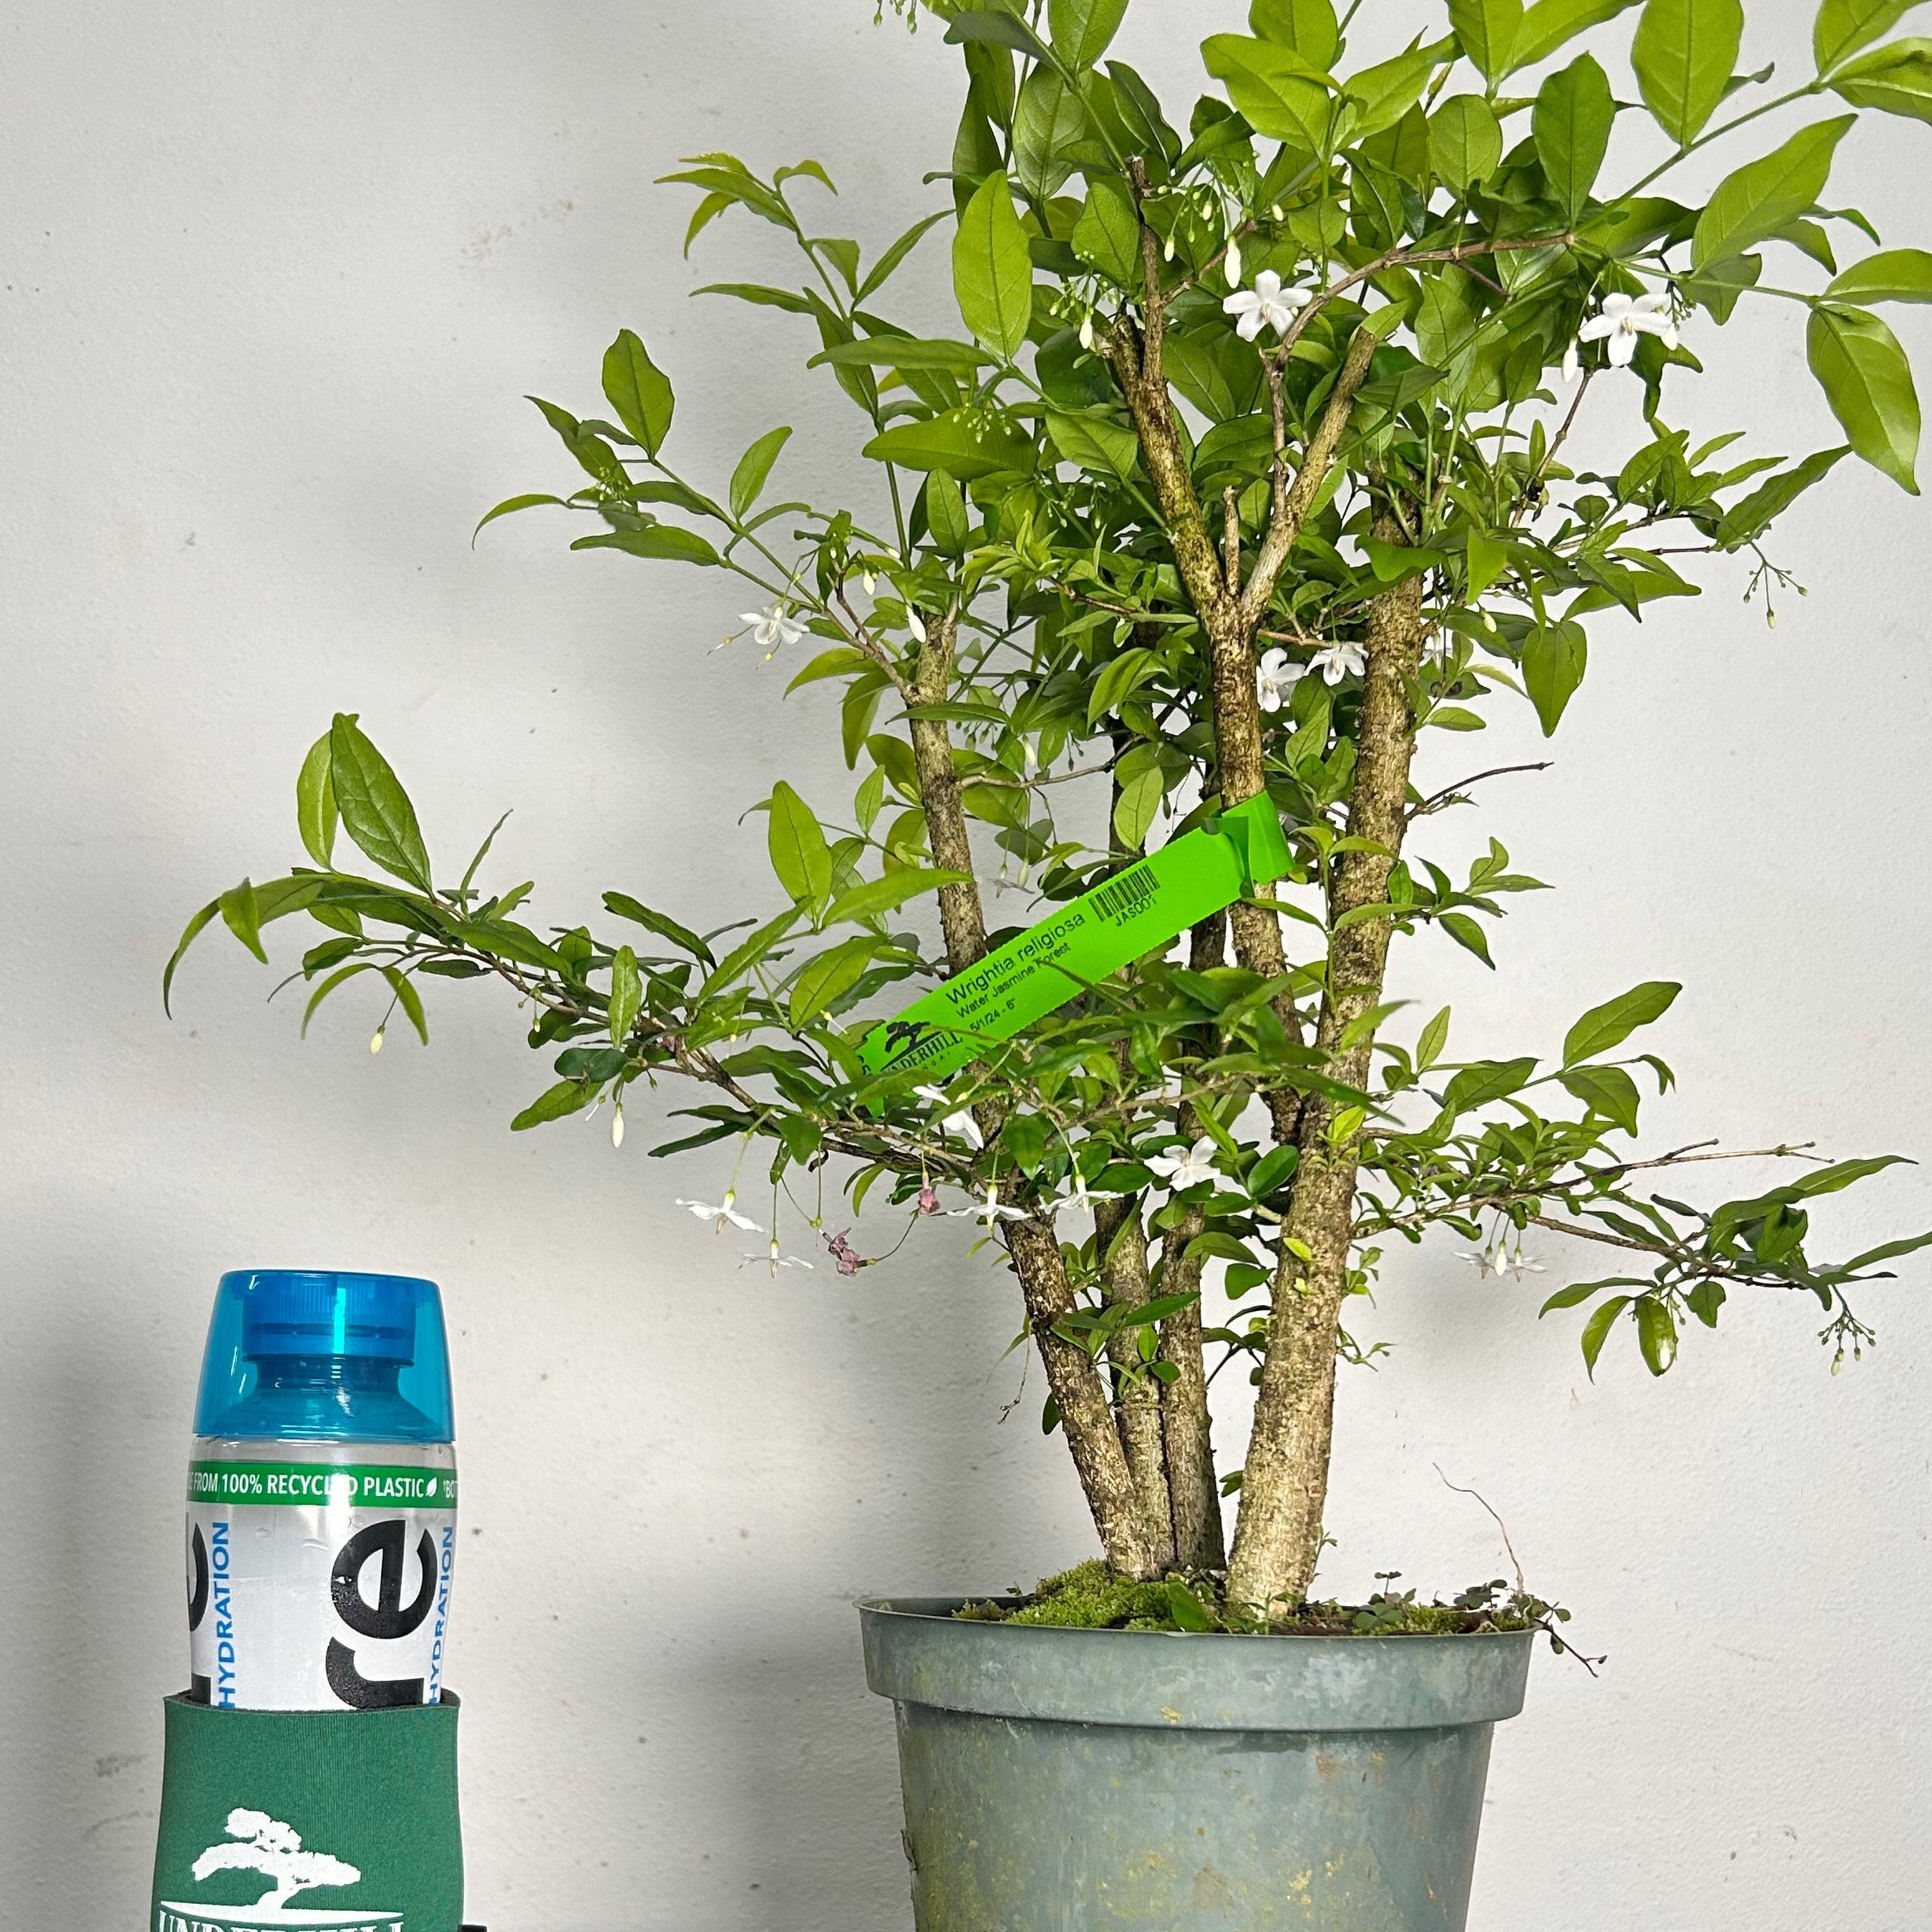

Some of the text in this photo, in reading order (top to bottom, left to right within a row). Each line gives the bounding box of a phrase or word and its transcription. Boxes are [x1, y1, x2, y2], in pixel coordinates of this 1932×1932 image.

[946, 913, 1085, 1004] Wrightia religiosa
[956, 942, 1071, 1018] Water Jasmine Forest
[886, 1032, 963, 1071] NDERHILL
[969, 1009, 1001, 1032] 5/1/24
[194, 1472, 219, 1493] FROM
[222, 1474, 263, 1494] 100%
[267, 1475, 358, 1496] RECYCLD
[364, 1476, 424, 1498] PLASTIC
[212, 1521, 235, 1708] HYDRATION
[429, 1526, 453, 1704] HYDRATION
